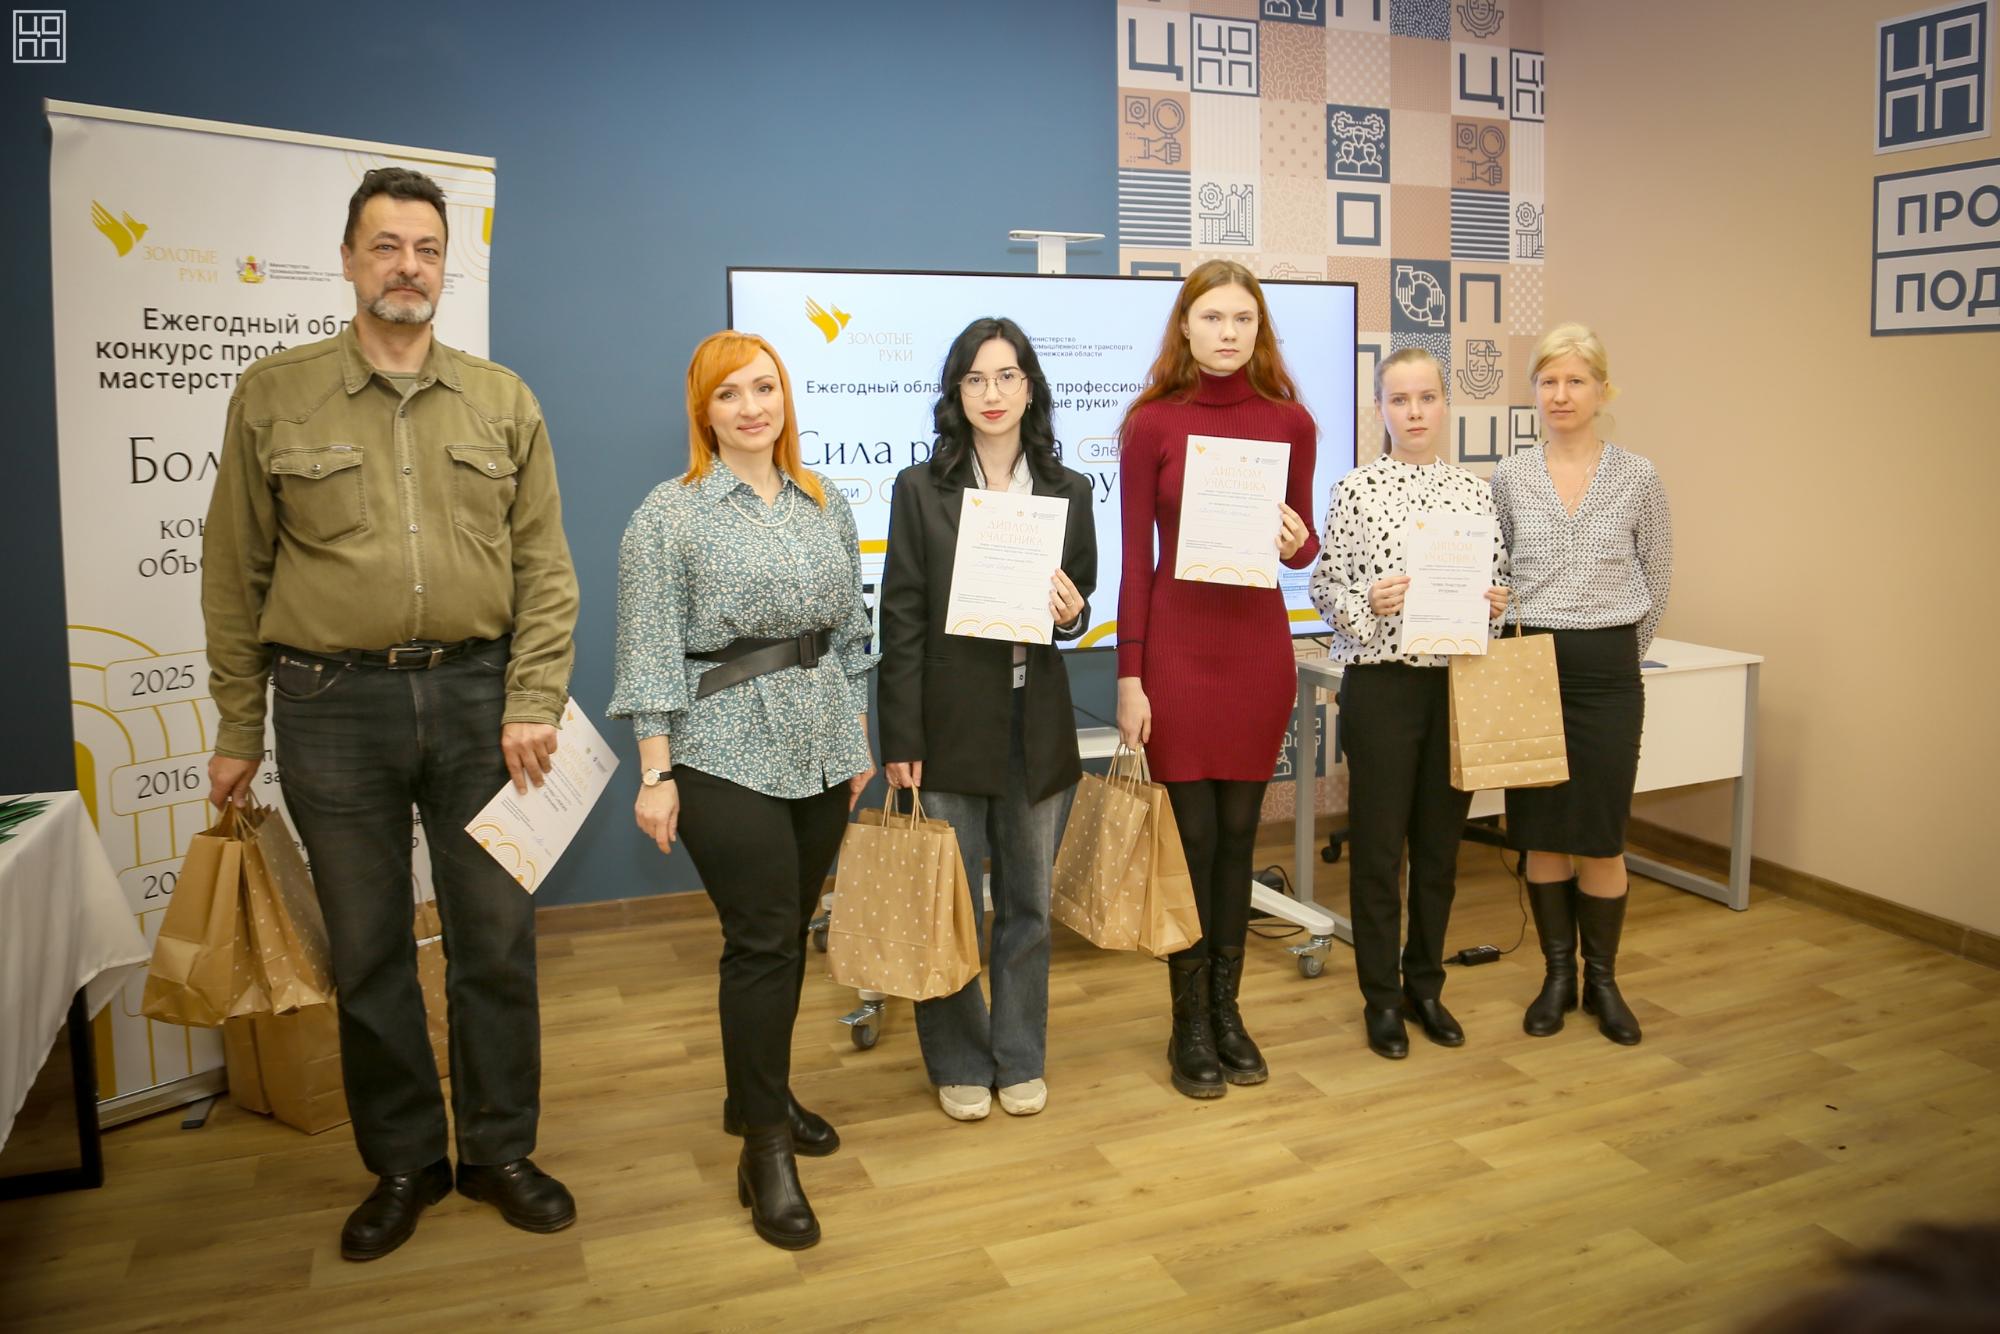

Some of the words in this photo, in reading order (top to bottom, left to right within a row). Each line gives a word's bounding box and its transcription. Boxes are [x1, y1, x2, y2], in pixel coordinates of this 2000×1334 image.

[143, 246, 219, 264] ЗОЛОТЫЕ
[179, 268, 219, 284] РУКИ
[144, 308, 299, 337] Ежегодный
[847, 332, 913, 345] ЗОЛОТЫЕ
[96, 341, 213, 365] конкурс
[879, 349, 913, 362] РУКИ
[806, 380, 899, 395] Ежегодный
[1076, 398, 1118, 411] руки»
[798, 430, 893, 466] Сила
[138, 549, 203, 578] объ
[130, 665, 195, 696] 2025
[136, 766, 200, 799] 2016
[142, 871, 181, 900] 20
